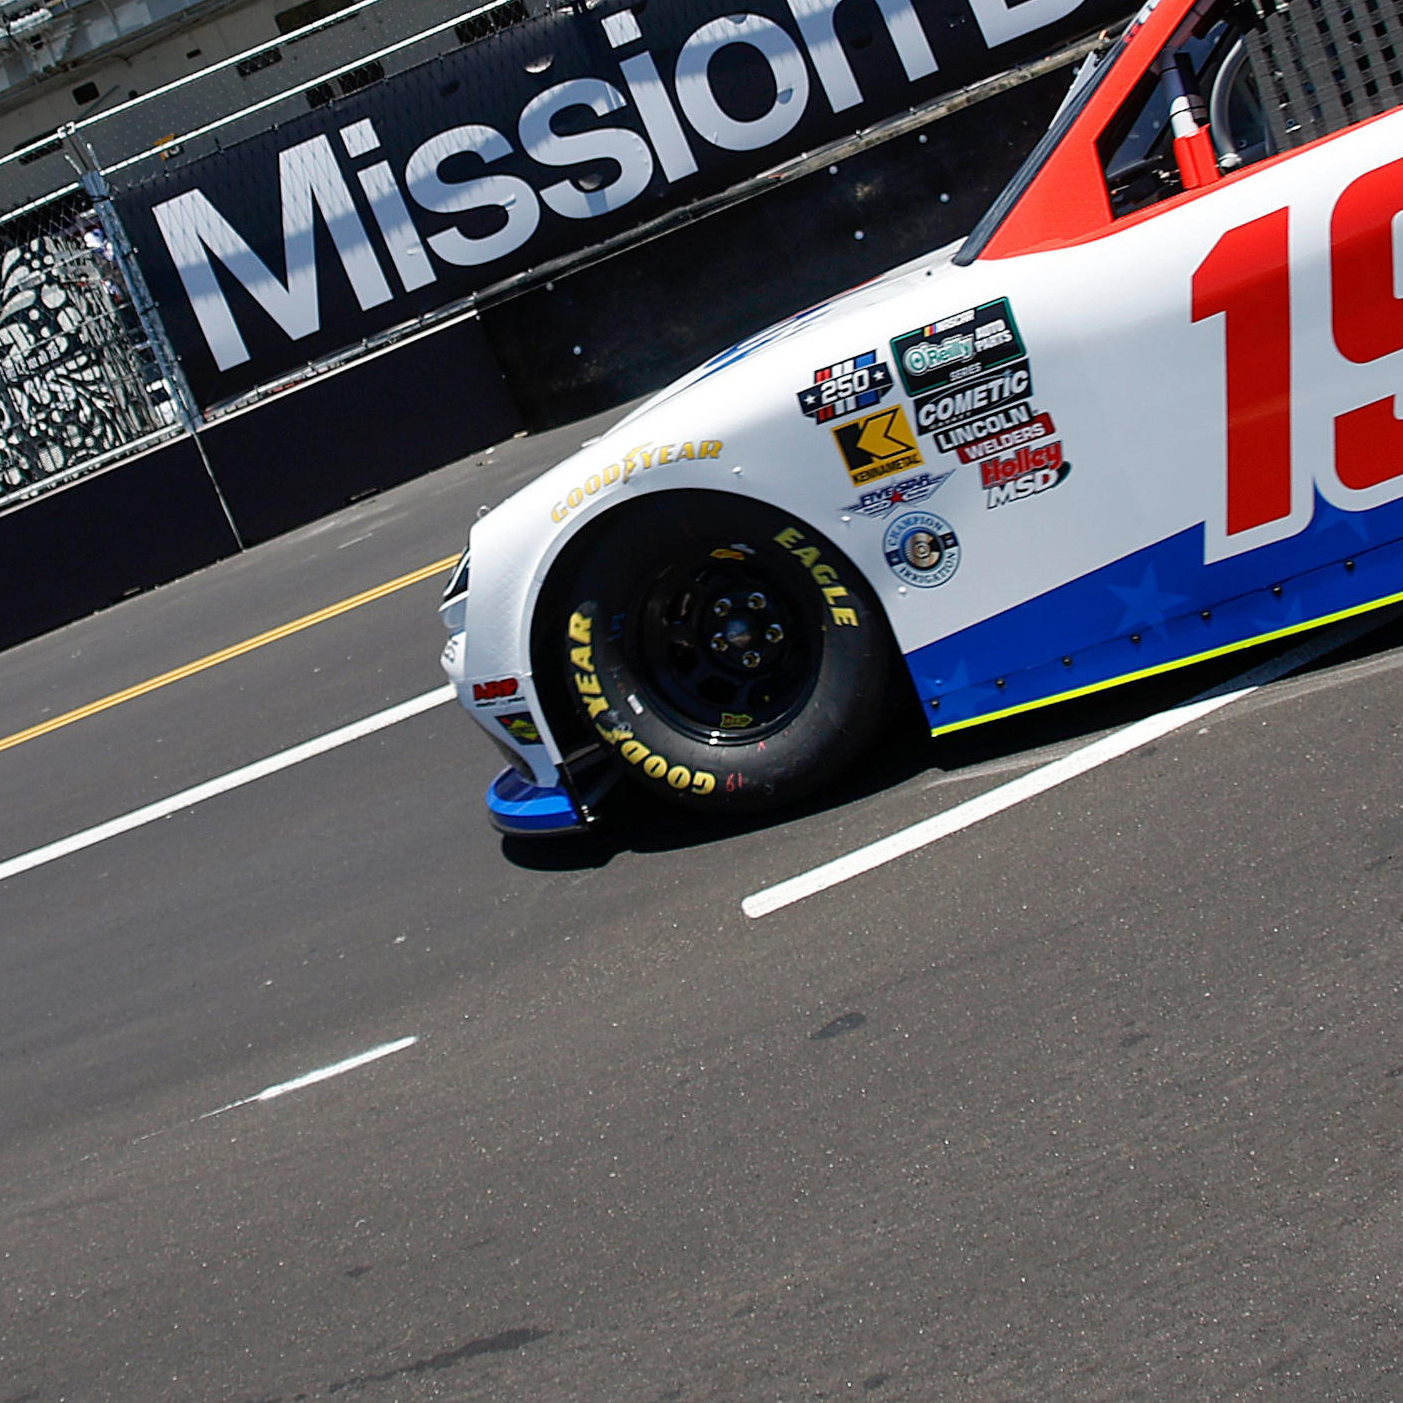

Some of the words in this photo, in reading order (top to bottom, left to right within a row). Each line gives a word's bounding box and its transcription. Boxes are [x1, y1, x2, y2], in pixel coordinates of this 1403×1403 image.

[975, 329, 1013, 352] PARTS
[820, 370, 870, 405] 250
[949, 362, 982, 381] SERIES
[918, 370, 1029, 426] COMETIC
[937, 406, 1030, 451] LINCOLN
[965, 422, 1046, 461] WELDERS
[551, 440, 722, 523] GOODYEAR
[852, 455, 922, 485] KENNAMETAL
[981, 440, 1063, 487] Holley
[860, 486, 895, 507] FIVE
[986, 468, 1060, 509] MSD
[888, 516, 944, 547] CHAMPION
[774, 527, 859, 628] EAGLE
[569, 611, 717, 795] GOODYEAR
